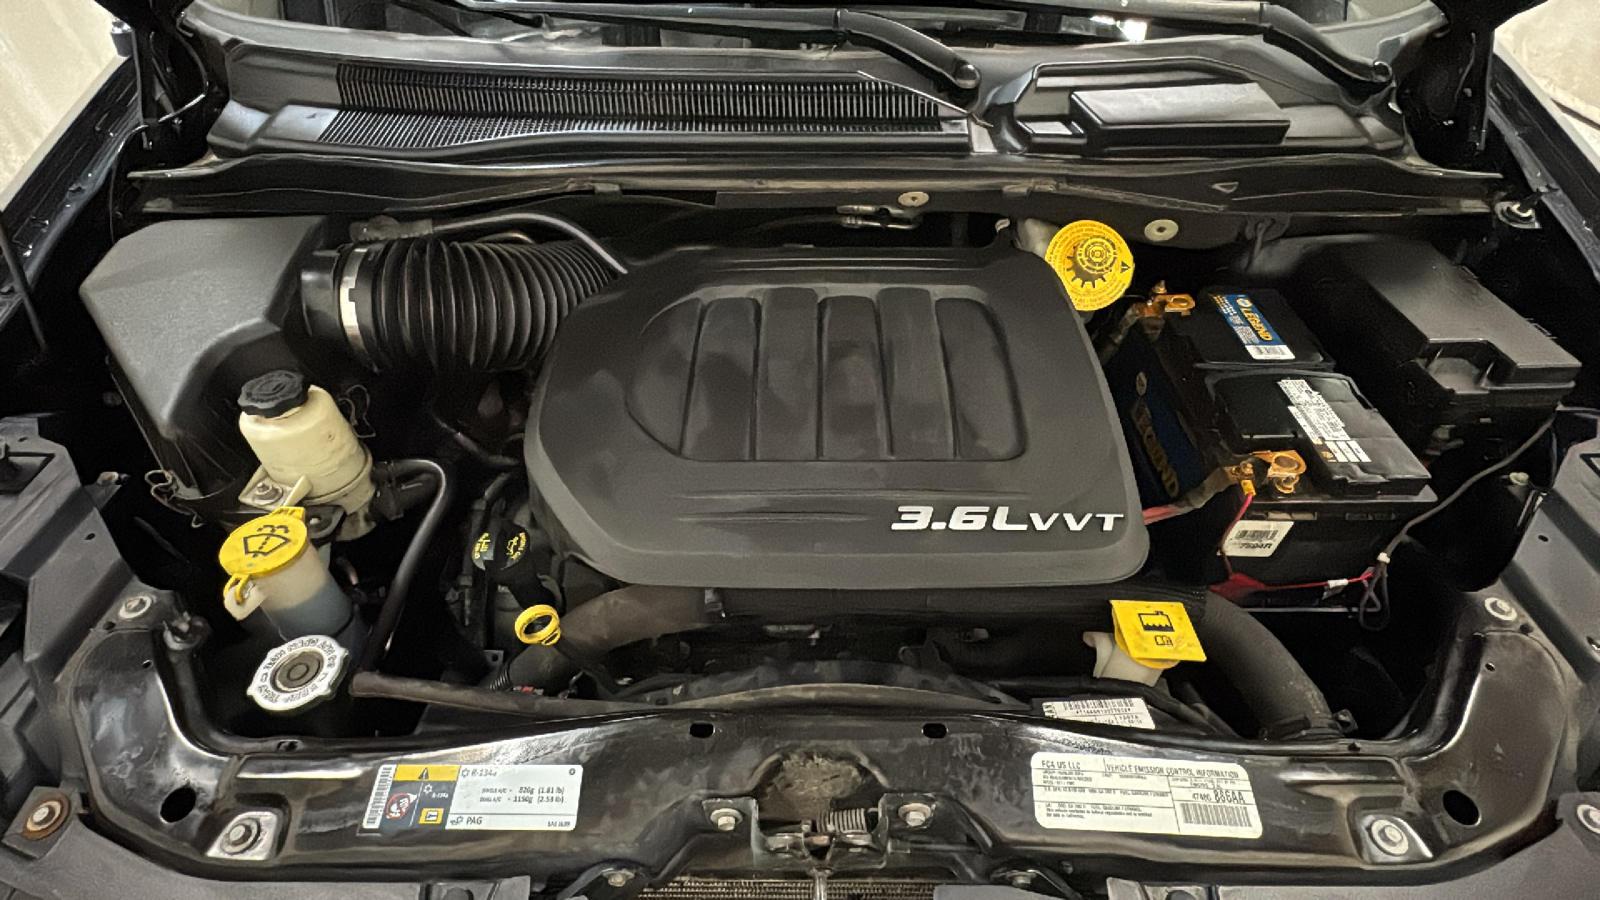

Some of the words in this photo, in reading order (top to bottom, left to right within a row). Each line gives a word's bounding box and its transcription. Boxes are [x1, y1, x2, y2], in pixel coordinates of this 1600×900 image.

[1240, 308, 1272, 340] LEGEND
[1042, 760, 1055, 769] FCA
[1057, 761, 1066, 769] US
[1068, 761, 1080, 770] LLC
[1106, 764, 1132, 772] VEHICLE
[1134, 765, 1164, 774] EMISSION
[1166, 767, 1195, 776] CONTROL
[1196, 769, 1239, 778] INFORMATION
[466, 816, 483, 825] PAG
